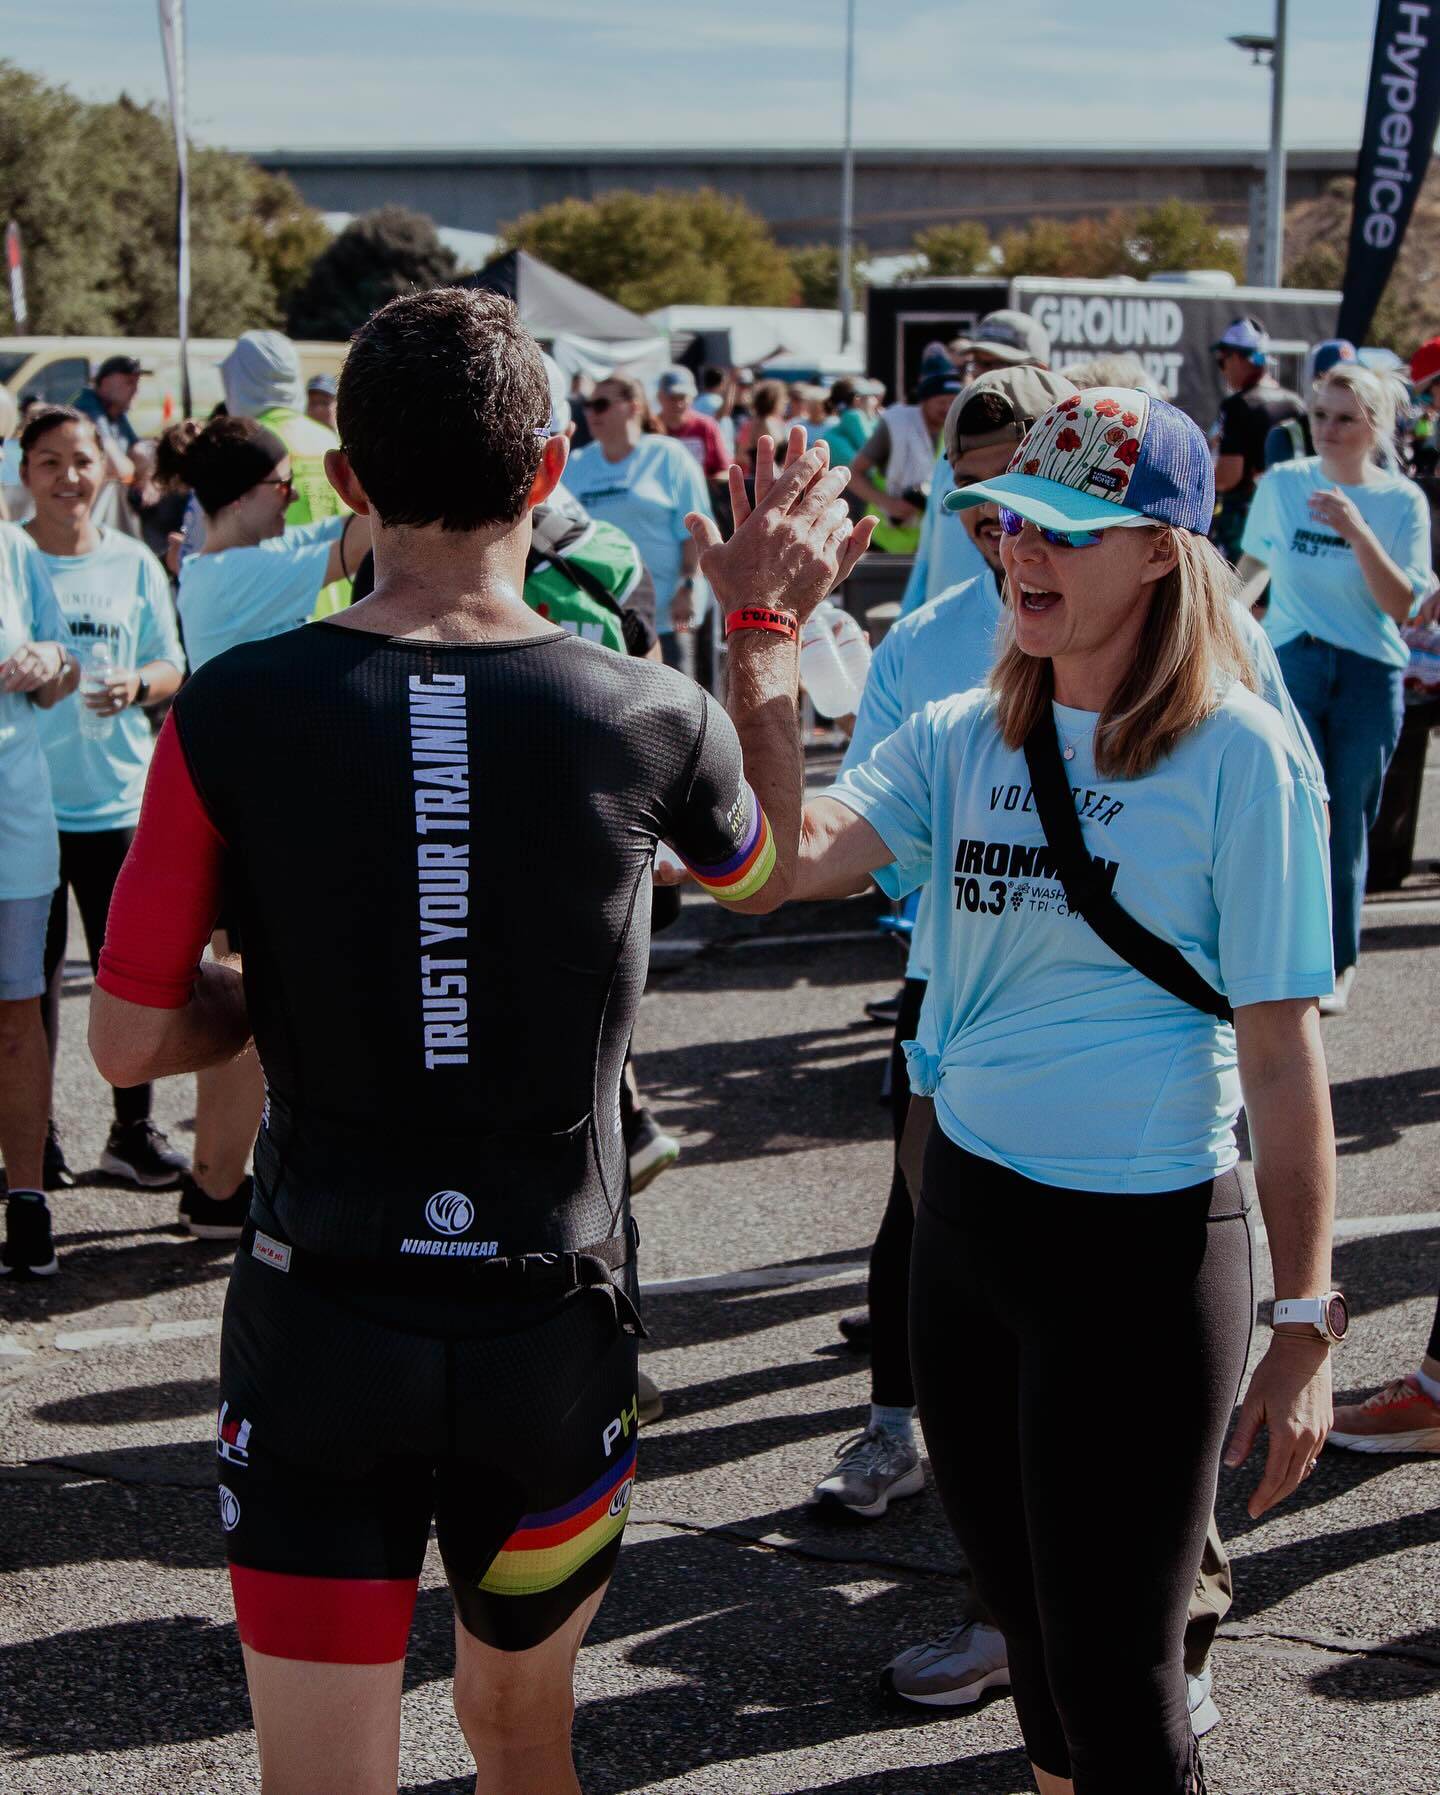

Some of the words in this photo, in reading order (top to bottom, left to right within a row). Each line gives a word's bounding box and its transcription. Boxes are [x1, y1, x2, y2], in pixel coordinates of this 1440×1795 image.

[1363, 3, 1430, 248] Hyperice
[1031, 296, 1184, 346] GROUND
[409, 673, 471, 835] TRAINING
[990, 784, 1125, 826] VOLTEER
[417, 843, 470, 947] YOUR
[421, 954, 469, 1071] TRUST
[400, 1238, 499, 1257] NIMBLEWEAR
